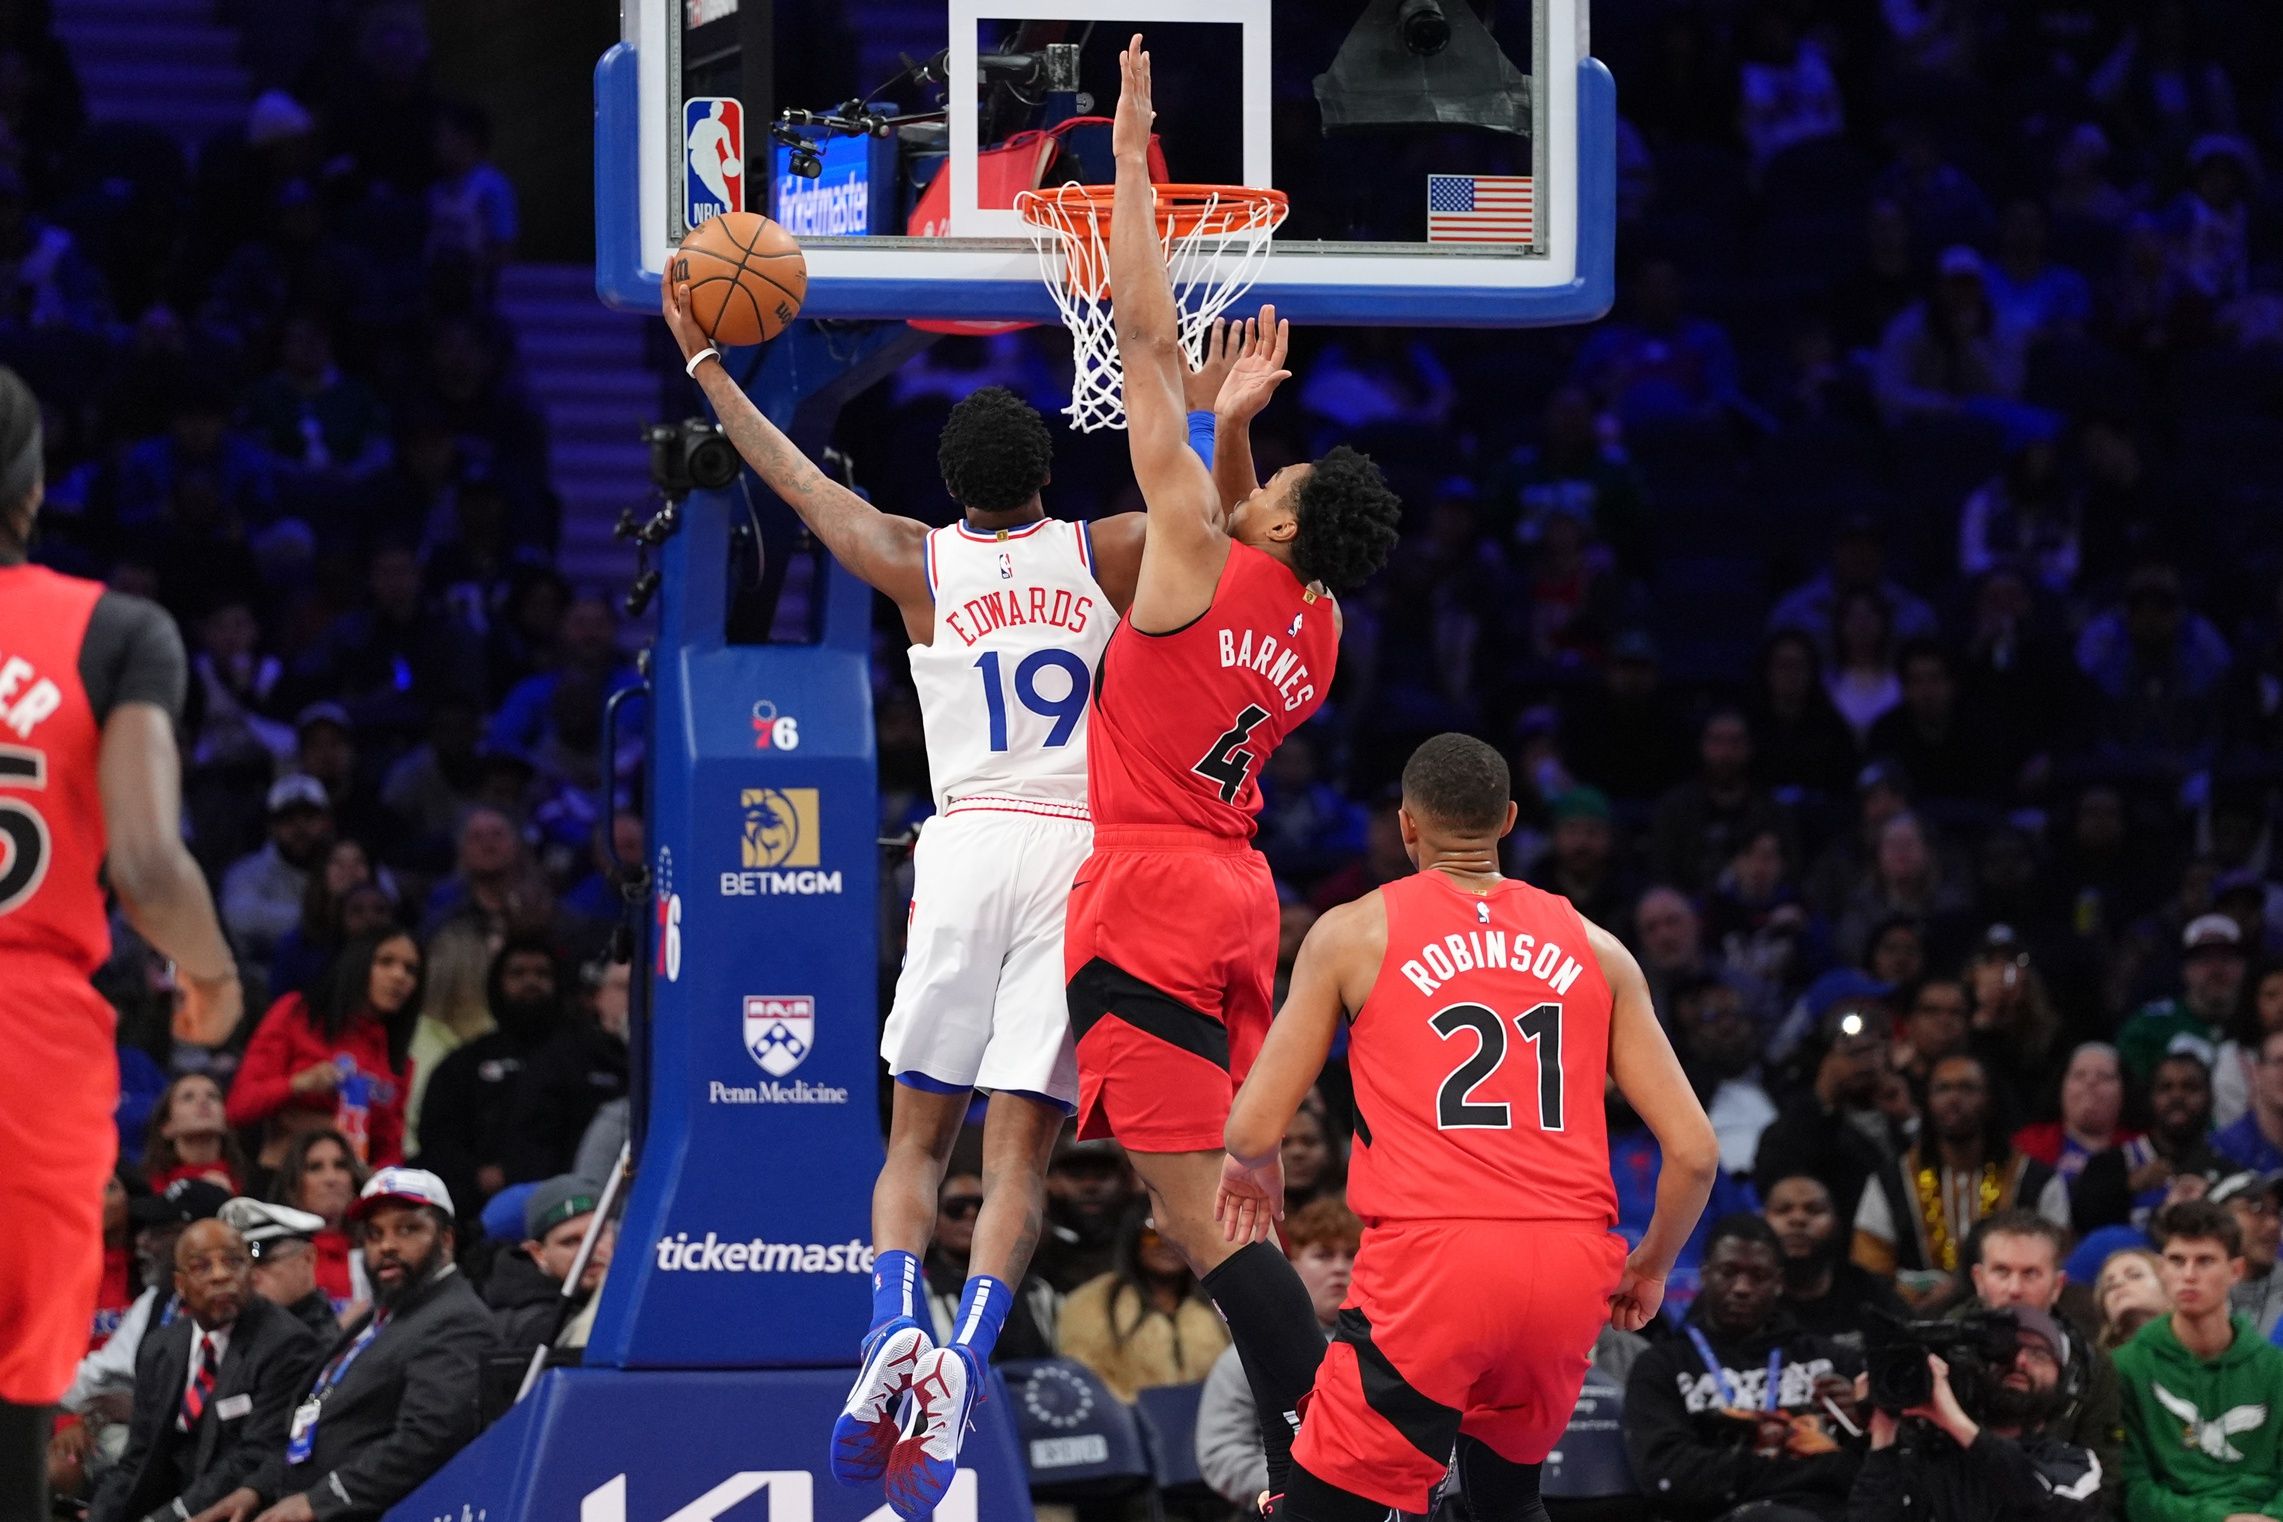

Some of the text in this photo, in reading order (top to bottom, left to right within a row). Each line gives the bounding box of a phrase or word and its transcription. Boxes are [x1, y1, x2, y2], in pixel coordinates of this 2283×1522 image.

[693, 202, 722, 224] NBA
[945, 586, 1094, 647] EDWARDS
[0, 655, 62, 740] ER
[973, 648, 1091, 753] 19
[1218, 627, 1314, 713] BARNES
[752, 715, 800, 751] 76
[1190, 702, 1272, 806] 4
[720, 870, 842, 896] BETMGM
[1400, 930, 1584, 998] ROBINSON
[709, 1078, 849, 1104] Penn Medicine
[1426, 1001, 1565, 1132] 21
[656, 1231, 874, 1274] ticketmaste
